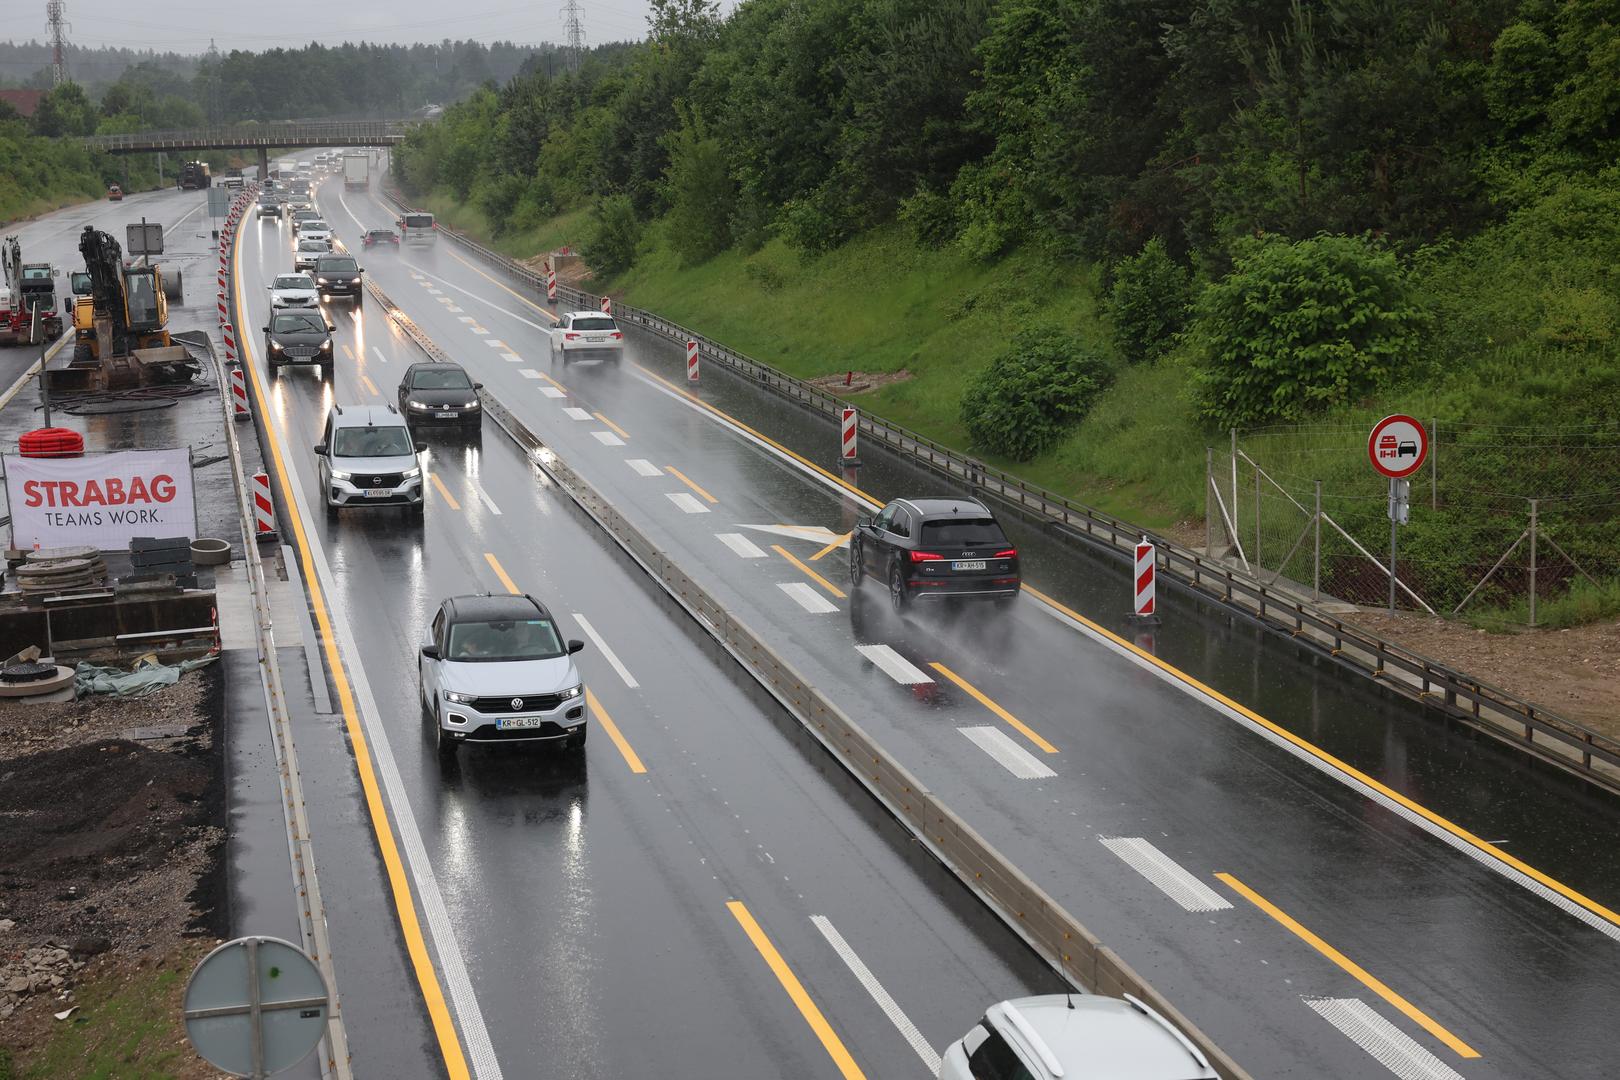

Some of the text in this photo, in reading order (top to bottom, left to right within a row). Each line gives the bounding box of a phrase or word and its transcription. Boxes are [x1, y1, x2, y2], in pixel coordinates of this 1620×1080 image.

[24, 474, 176, 507] STRABAG
[45, 508, 164, 526] TEAMS WORK.
